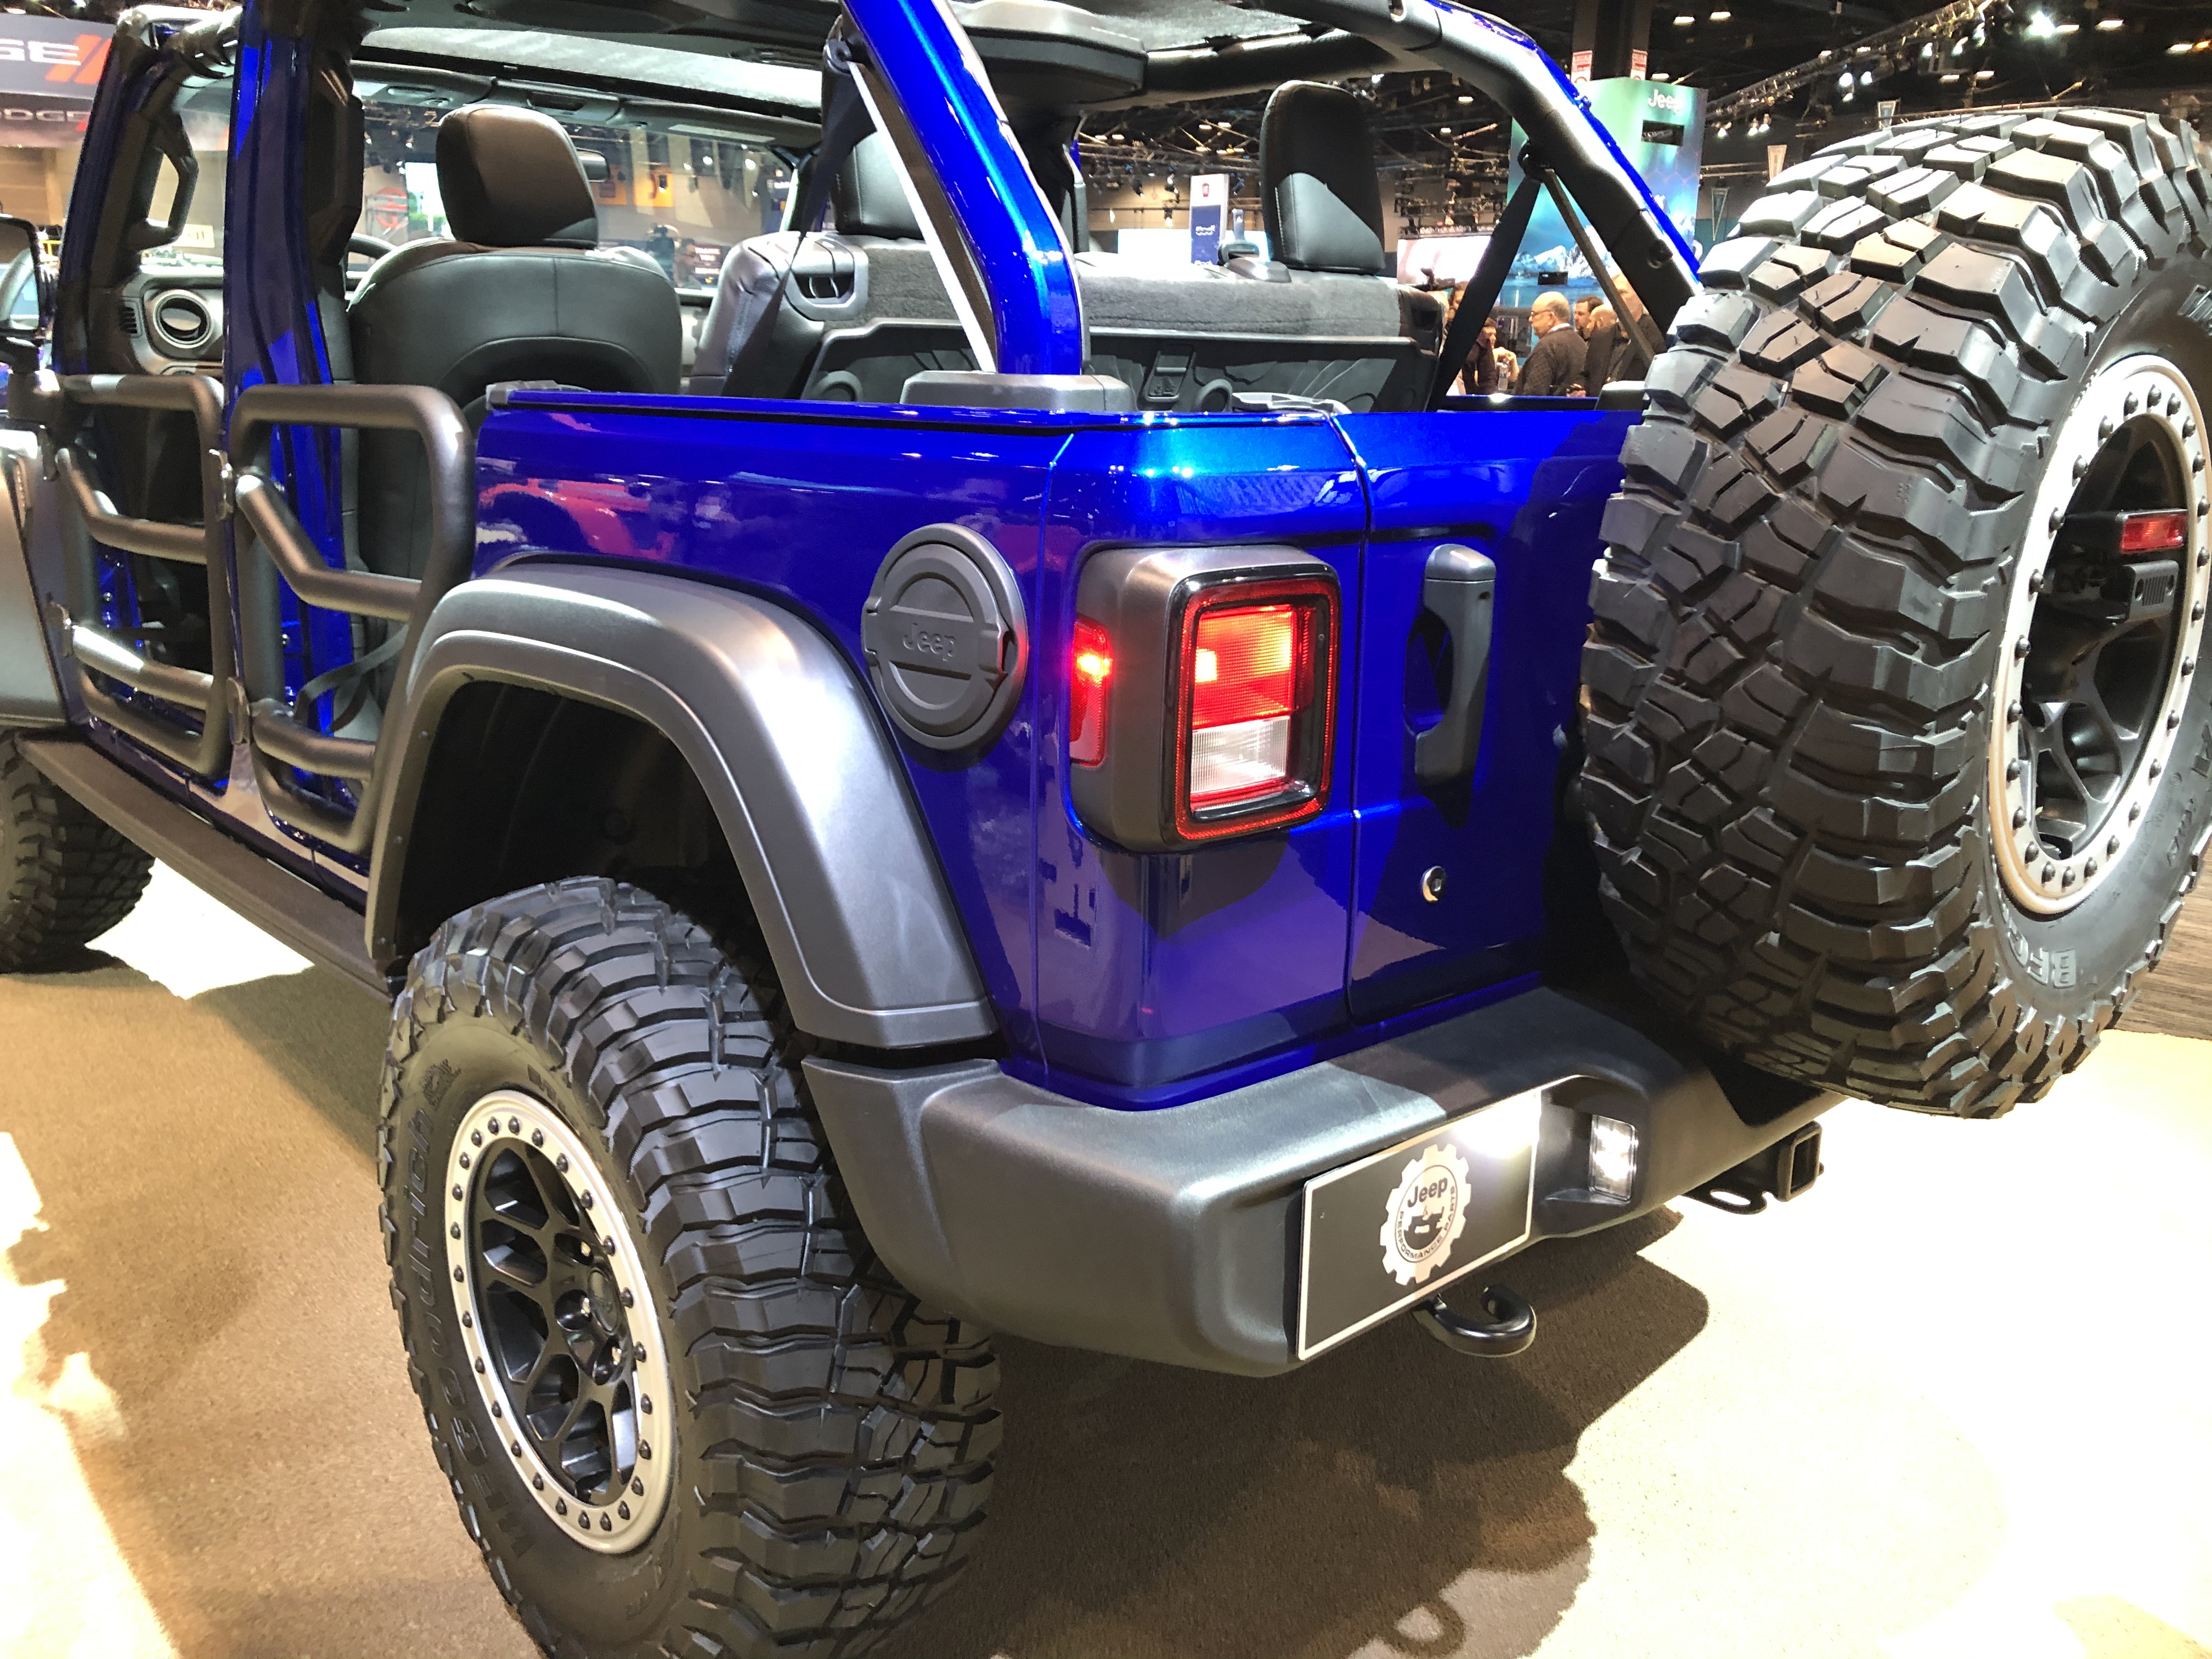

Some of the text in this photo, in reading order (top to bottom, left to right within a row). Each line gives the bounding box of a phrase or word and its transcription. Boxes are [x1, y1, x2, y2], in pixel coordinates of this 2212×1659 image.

[1647, 89, 1683, 114] Jeep
[902, 623, 956, 662] Jeep
[1407, 1177, 1448, 1208] Jeep
[1397, 1186, 1455, 1260] PERFORMANCE PARTS
